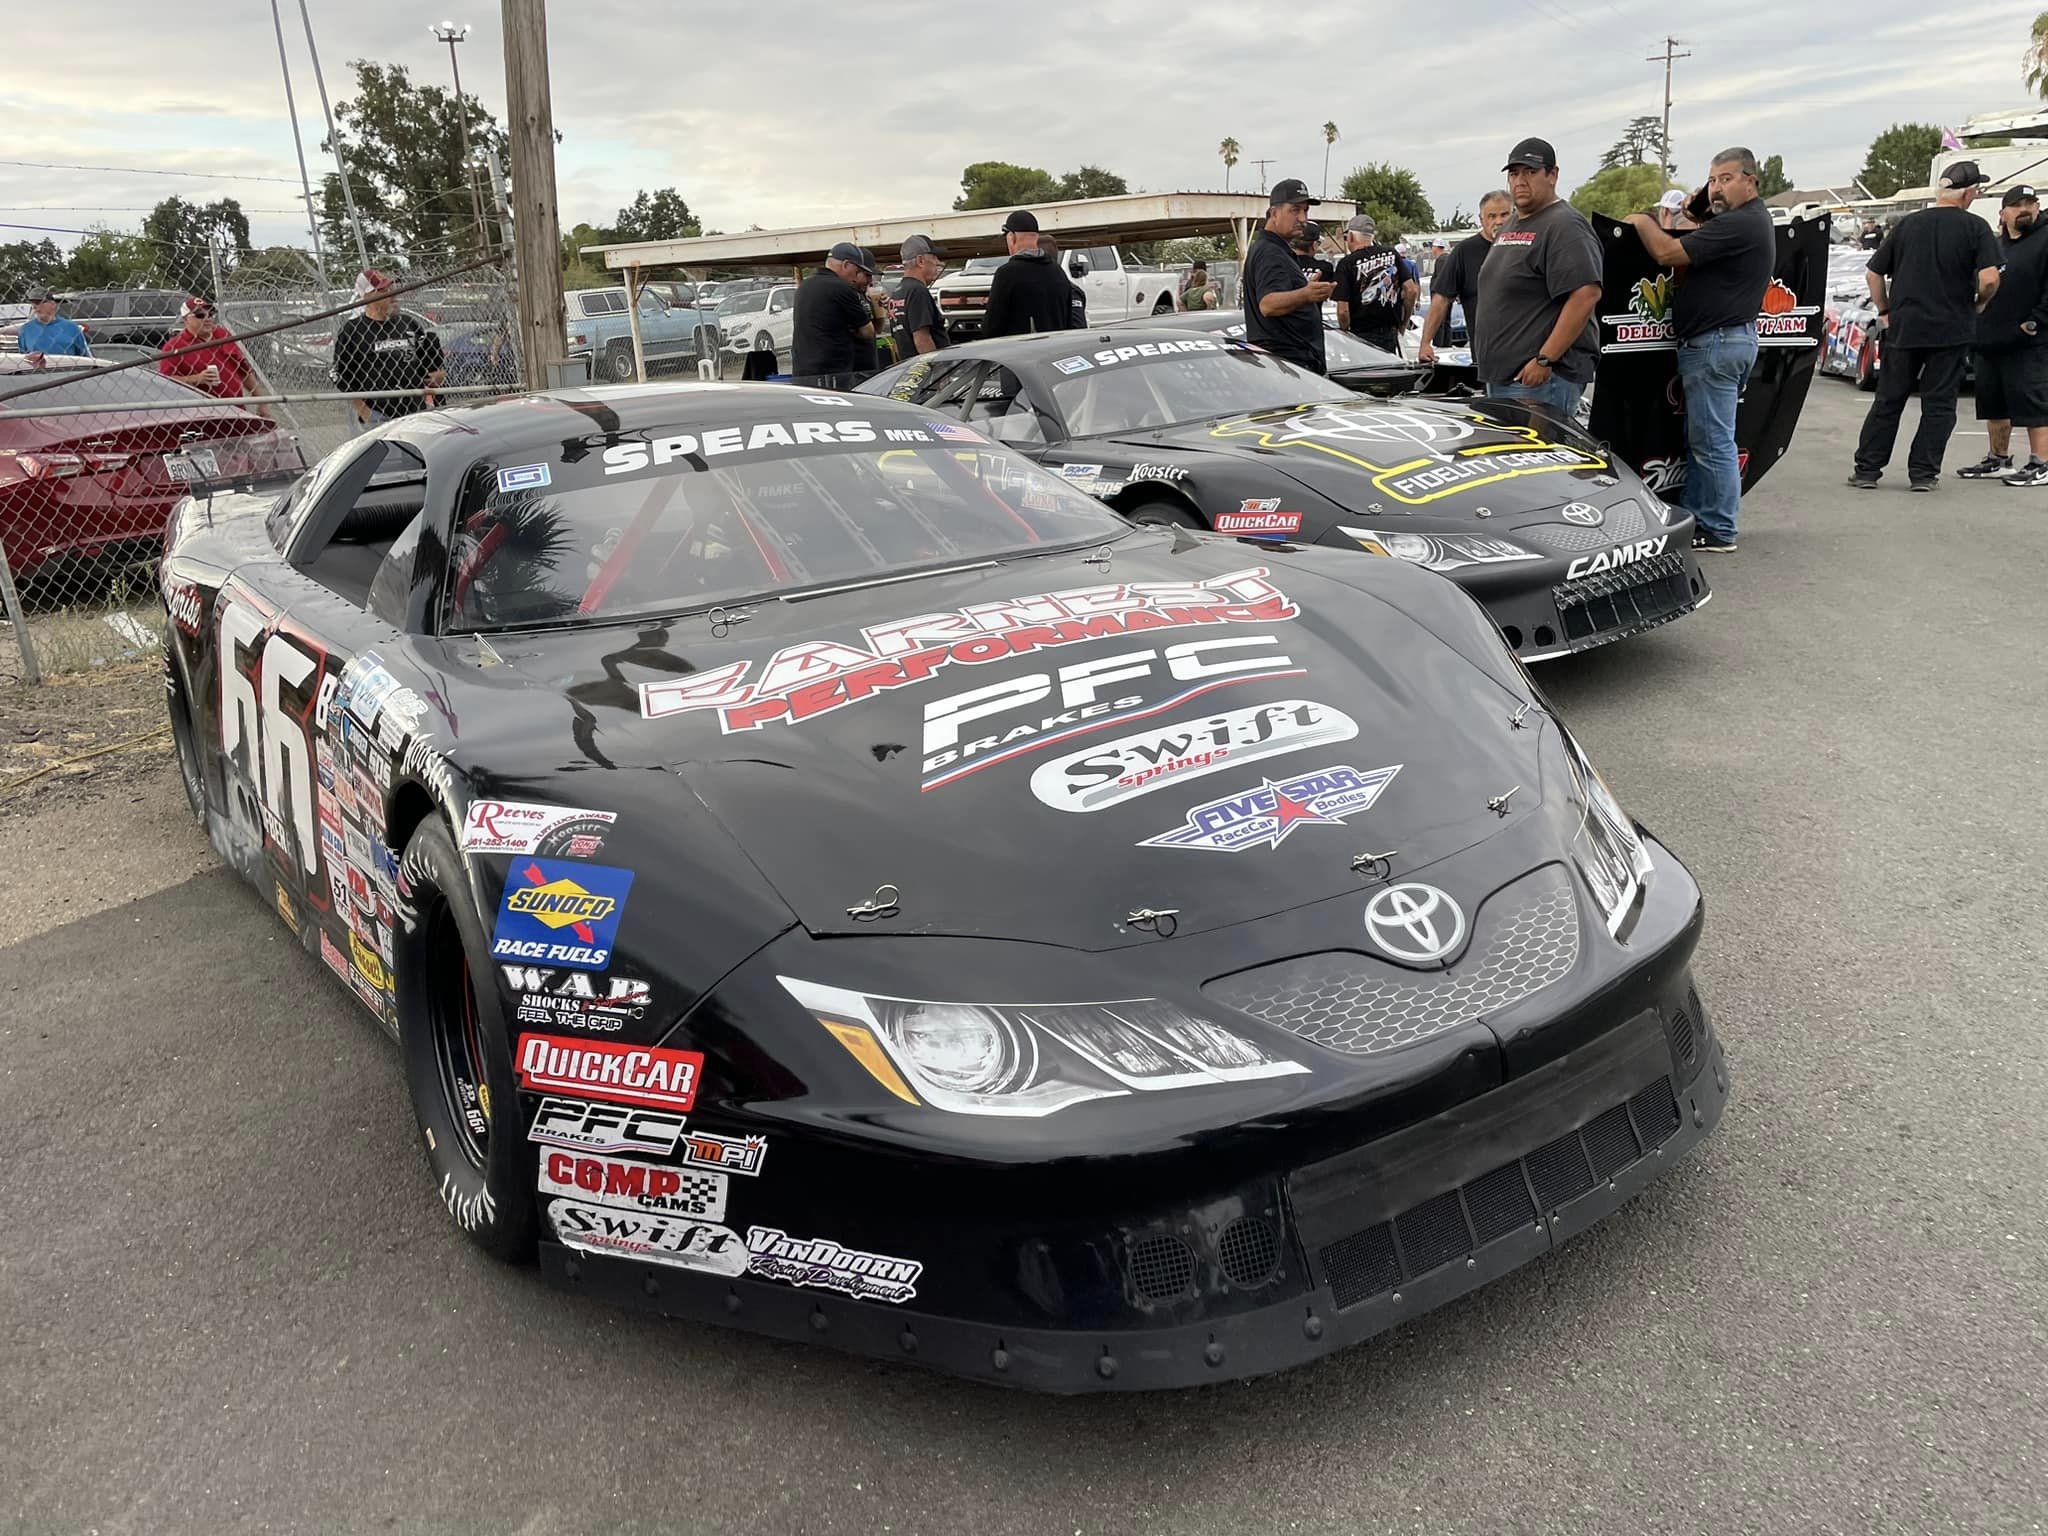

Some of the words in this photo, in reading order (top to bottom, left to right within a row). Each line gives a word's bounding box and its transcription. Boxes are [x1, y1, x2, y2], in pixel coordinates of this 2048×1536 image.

[1766, 318, 1806, 333] FARM
[1094, 340, 1218, 366] SPEARS
[602, 420, 877, 476] SPEARS
[884, 429, 934, 442] MFG.
[1126, 463, 1189, 481] Hoosier
[1391, 457, 1500, 495] FIDELITY
[1499, 449, 1592, 468] CAPITAL
[1567, 534, 1669, 580] CAMRY
[641, 567, 1272, 717] EARNEST
[722, 597, 1299, 733] PERFORMANCE
[923, 636, 1292, 754] PFC
[923, 695, 1142, 773] BRAKES
[1118, 747, 1229, 788] springs
[469, 802, 546, 839] Reeves
[578, 813, 613, 821] AWARD
[1196, 791, 1276, 834] FIVE
[1279, 769, 1360, 800] STAR
[1212, 818, 1274, 845] RaceCar
[1315, 790, 1367, 812] Bodies
[511, 890, 610, 917] SUNOCO
[493, 939, 549, 958] RACE
[547, 944, 608, 964] FUELS
[517, 1007, 552, 1023] FEEL
[555, 1012, 586, 1028] THE
[588, 1015, 623, 1031] GRIP
[522, 994, 581, 1012] SHOCKS
[533, 1127, 606, 1145] BRAKES
[536, 1101, 685, 1144] PFC
[548, 1153, 680, 1198] COMP
[638, 1194, 707, 1214] CAMS
[583, 1233, 655, 1252] springs
[751, 1256, 808, 1283] Racing
[804, 1265, 908, 1299] Development
